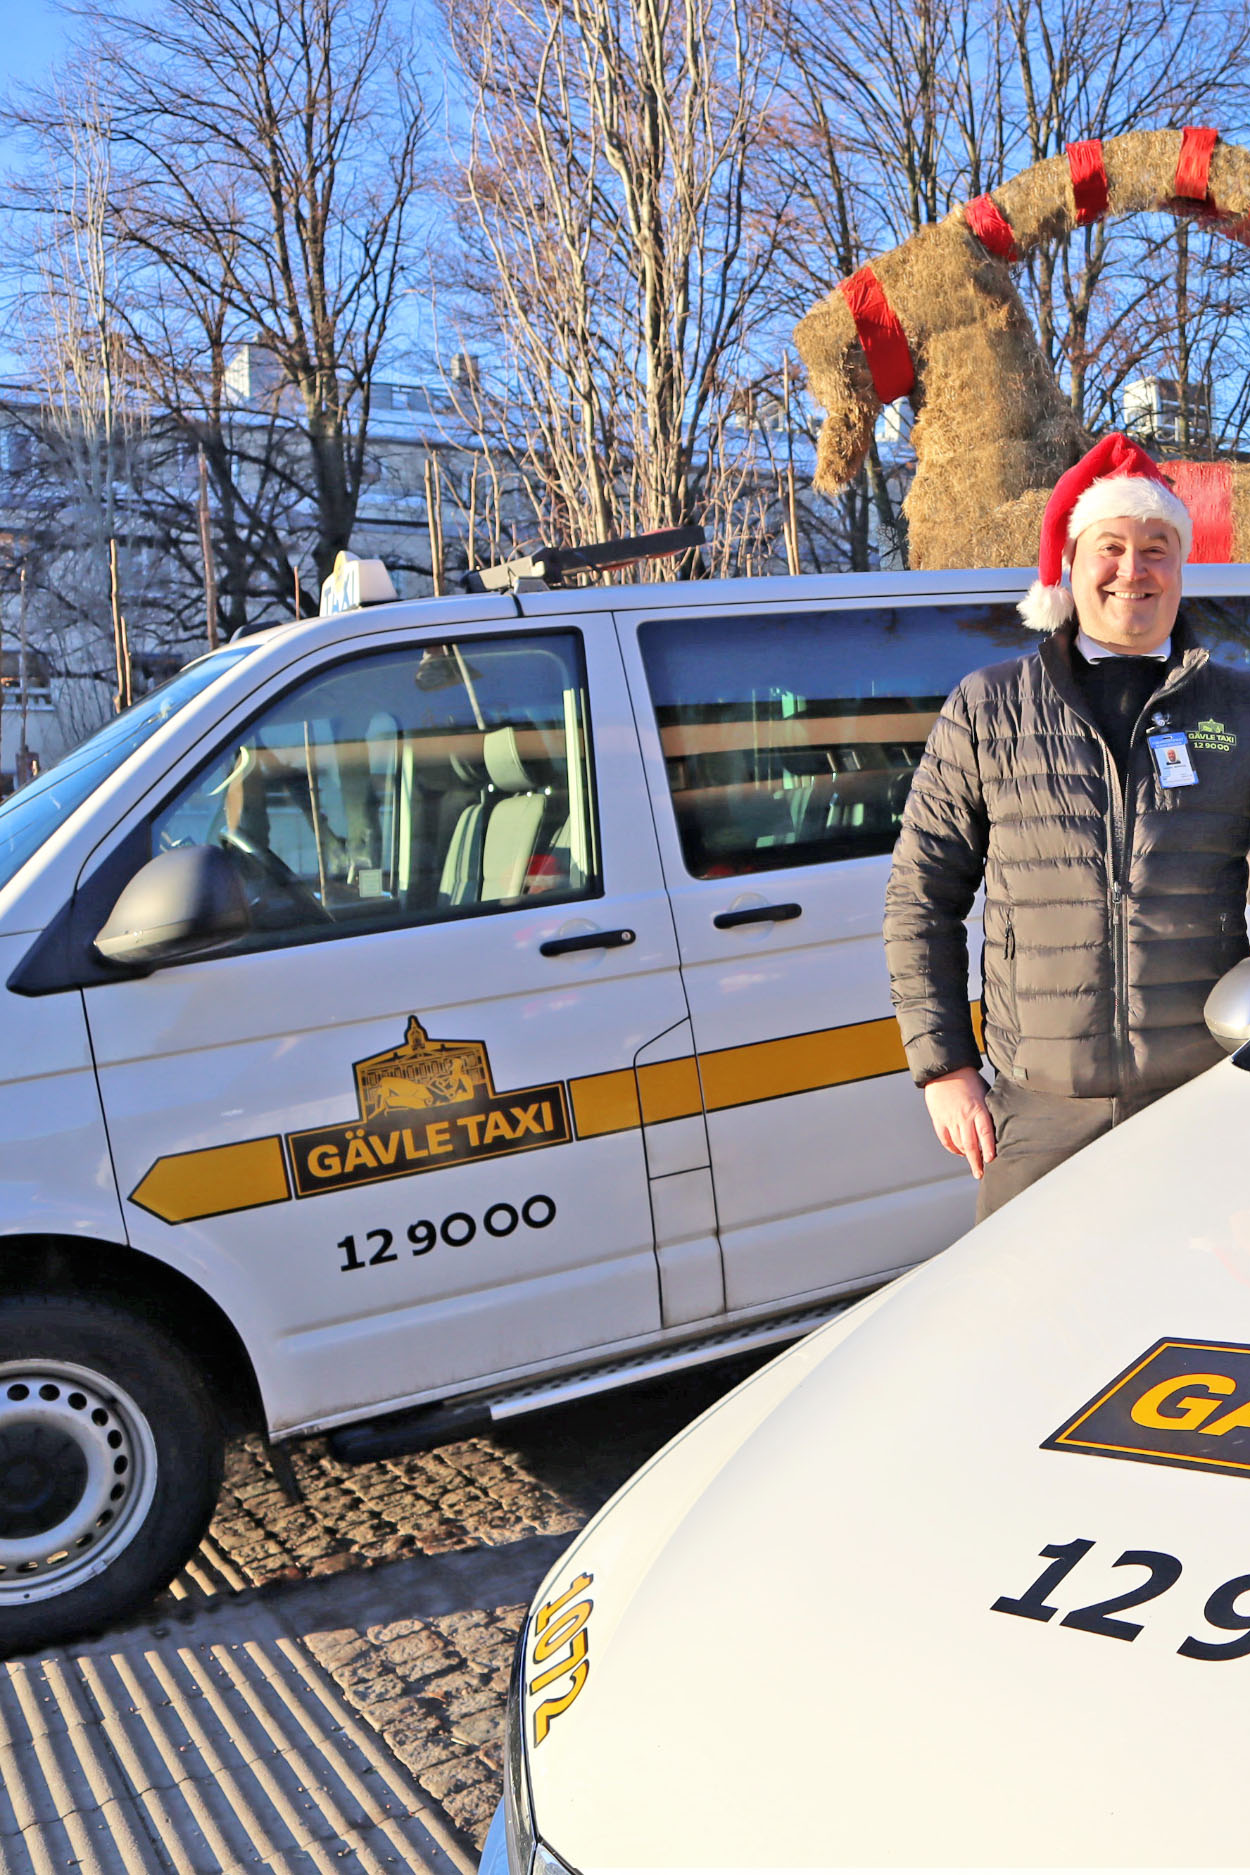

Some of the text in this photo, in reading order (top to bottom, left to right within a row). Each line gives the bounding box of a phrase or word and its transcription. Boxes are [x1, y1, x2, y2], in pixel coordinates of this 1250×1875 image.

[1188, 731, 1235, 743] GÄVLE TAXI
[307, 1102, 555, 1178] GÄVLE TAXI
[529, 1572, 594, 1749] 1072
